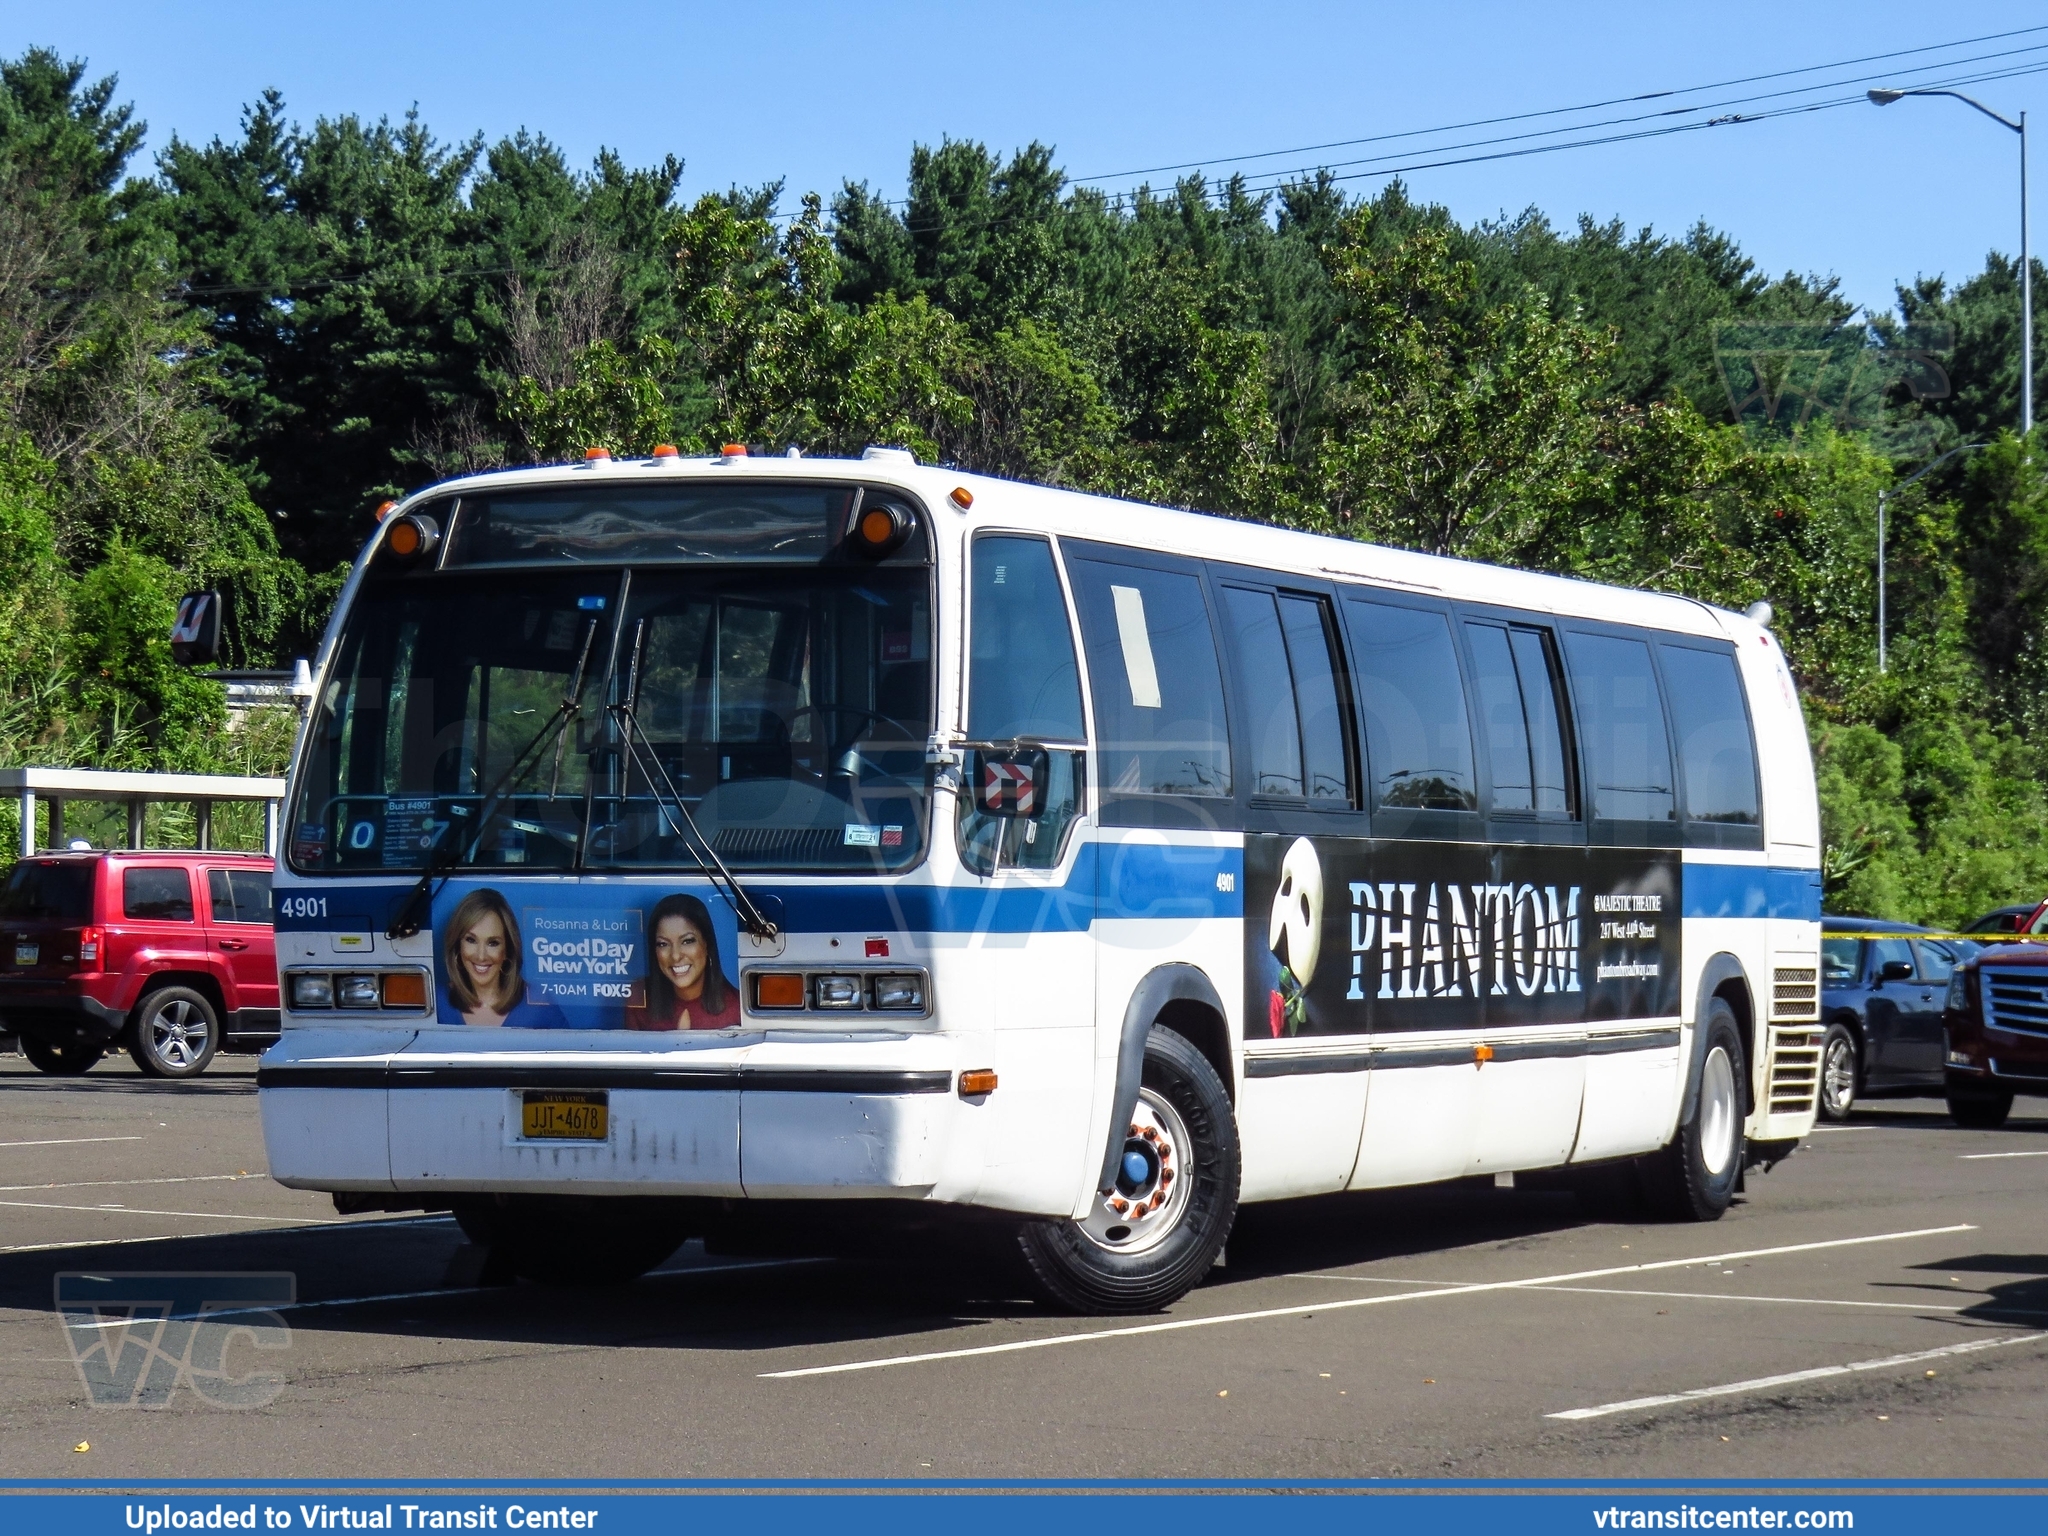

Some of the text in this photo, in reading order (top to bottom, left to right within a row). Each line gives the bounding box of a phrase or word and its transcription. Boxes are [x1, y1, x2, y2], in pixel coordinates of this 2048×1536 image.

[388, 801, 431, 811] Bus #4901
[1216, 872, 1234, 892] 4901
[281, 897, 327, 918] 4901
[1600, 895, 1662, 911] MAJESTIC THEATRE
[535, 917, 628, 931] Rosanna & Lori
[1600, 922, 1611, 939] 247
[1611, 922, 1626, 939] West
[1639, 922, 1656, 938] Street
[1346, 881, 1582, 1000] PHANTOM
[532, 937, 634, 962] Good Day
[538, 957, 629, 975] New York
[541, 983, 632, 997] 7-10AM FOX5
[543, 1095, 587, 1103] NEW YORK
